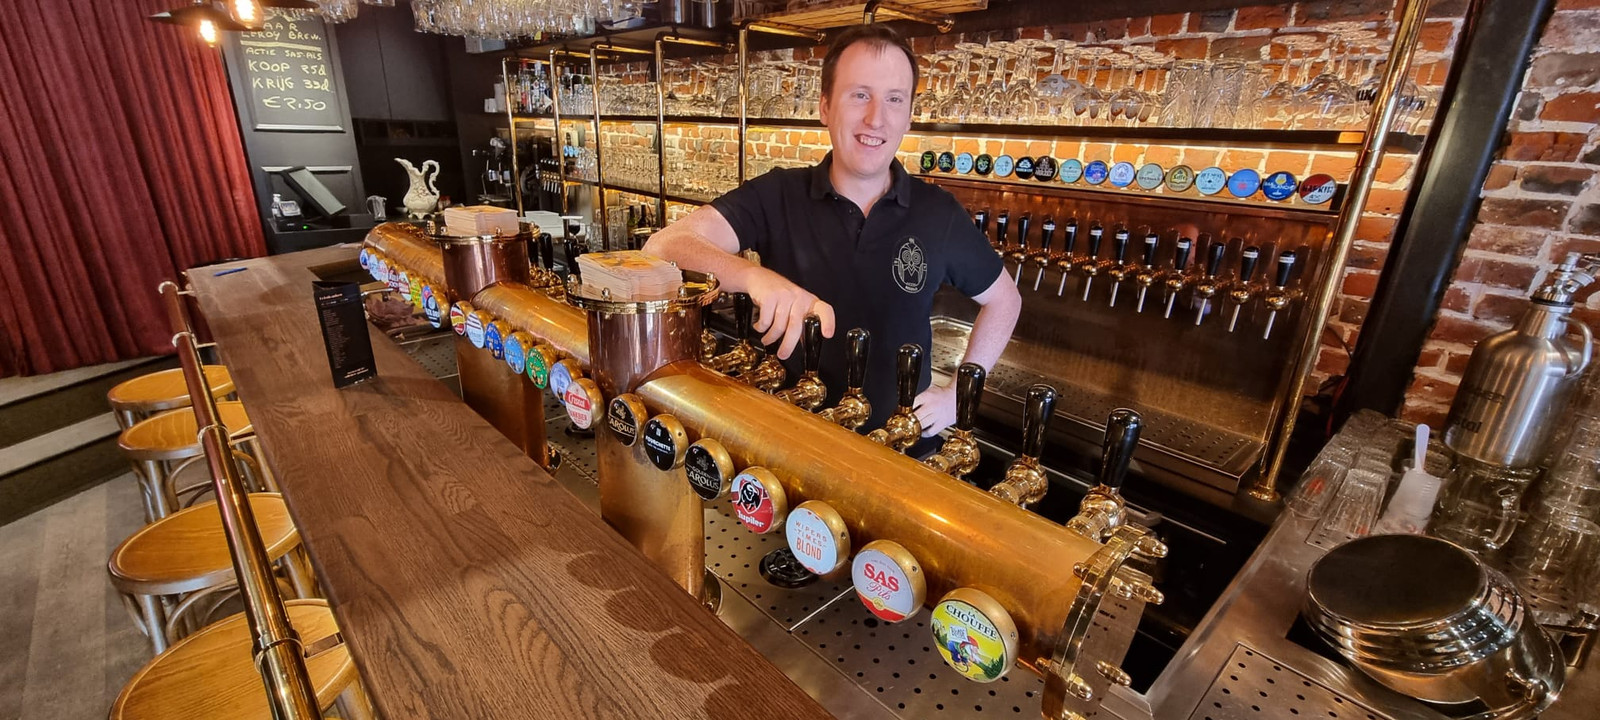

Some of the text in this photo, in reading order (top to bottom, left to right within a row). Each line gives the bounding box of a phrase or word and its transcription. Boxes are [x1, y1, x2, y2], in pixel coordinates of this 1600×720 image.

[241, 31, 280, 40] LEROY
[246, 47, 276, 55] ACTIE
[248, 60, 290, 72] KOOP
[608, 416, 635, 435] AROLUS
[686, 467, 719, 490] AROLUS
[737, 509, 765, 527] Jupiler
[795, 520, 827, 542] WIPERS
[796, 537, 822, 560] BLOND
[863, 562, 900, 592] SAS
[866, 581, 892, 600] Pils
[946, 604, 997, 639] CHOUFFE
